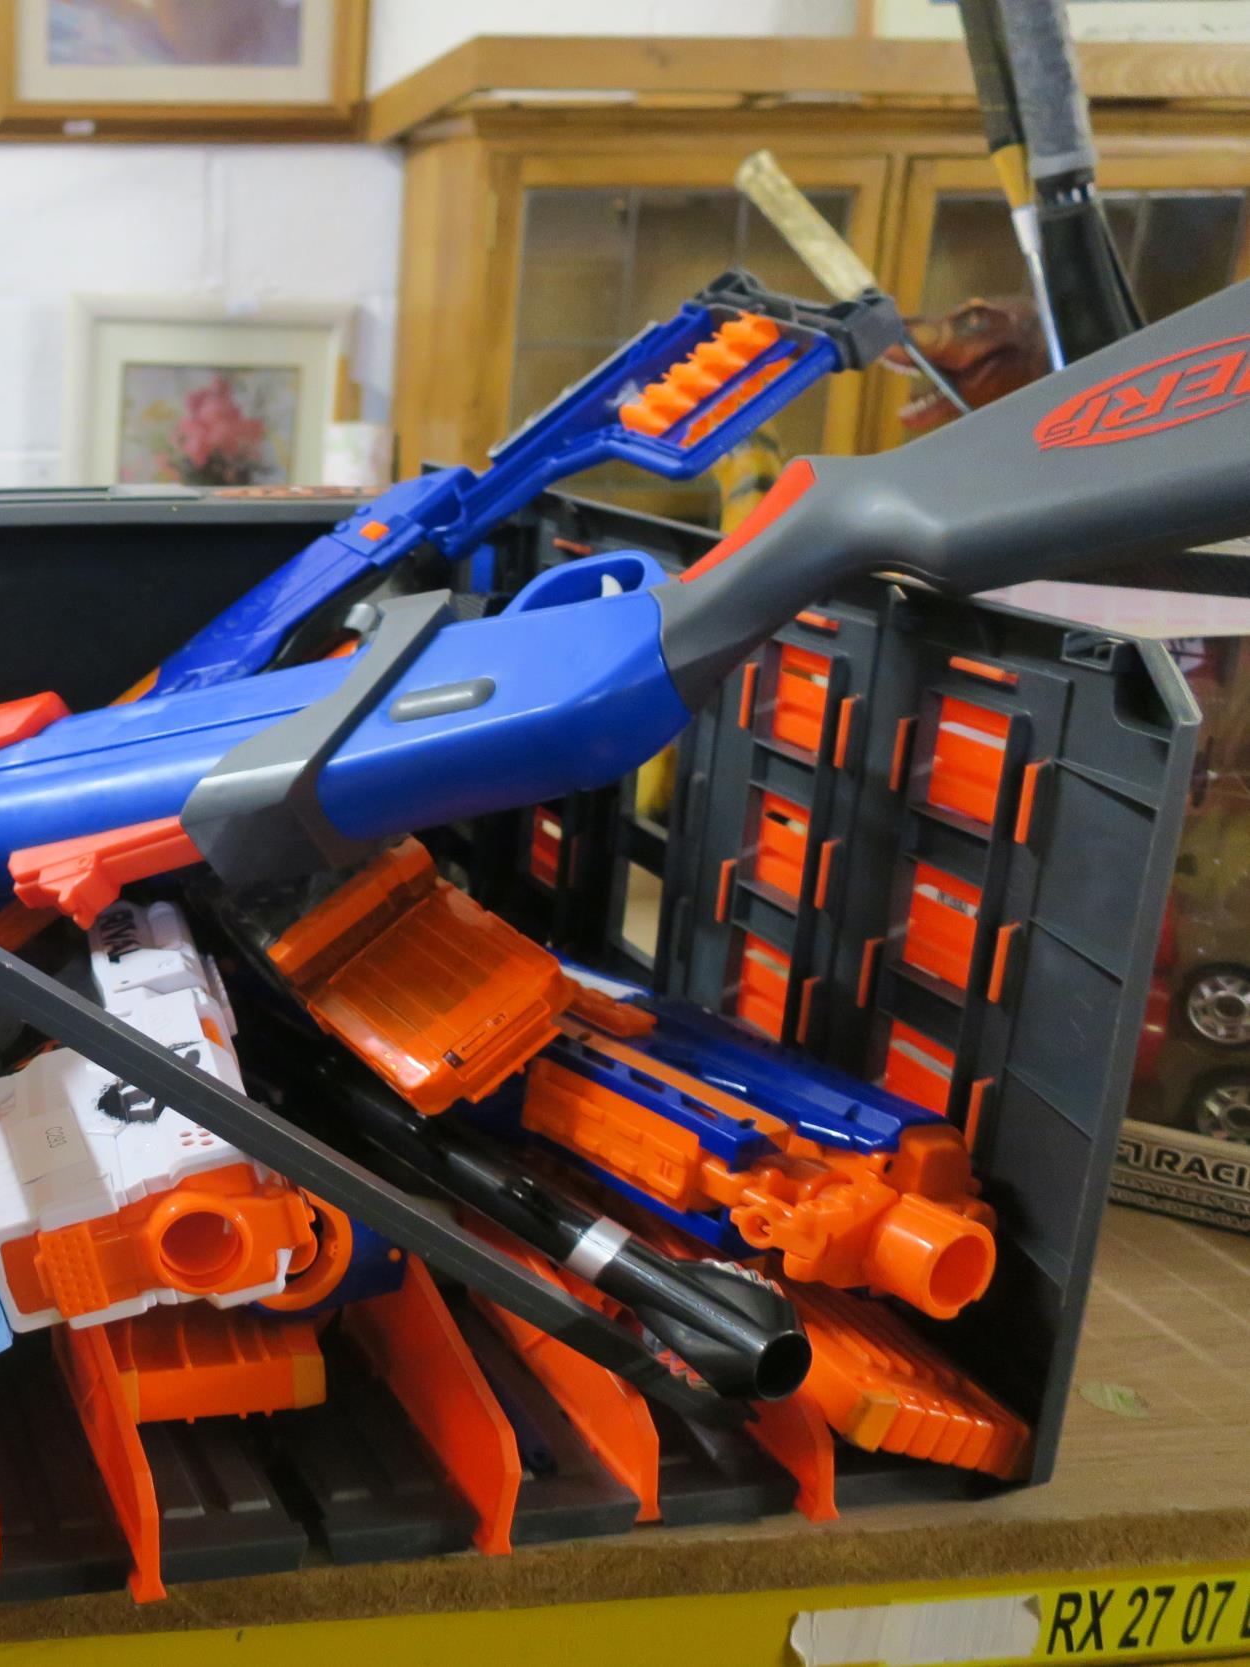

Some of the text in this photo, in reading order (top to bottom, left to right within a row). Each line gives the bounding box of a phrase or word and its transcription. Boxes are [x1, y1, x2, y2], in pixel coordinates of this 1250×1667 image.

[1036, 350, 1250, 451] ERF
[1046, 1589, 1115, 1655] RX
[1117, 1585, 1176, 1649] 27
[1181, 1581, 1237, 1644] 07
